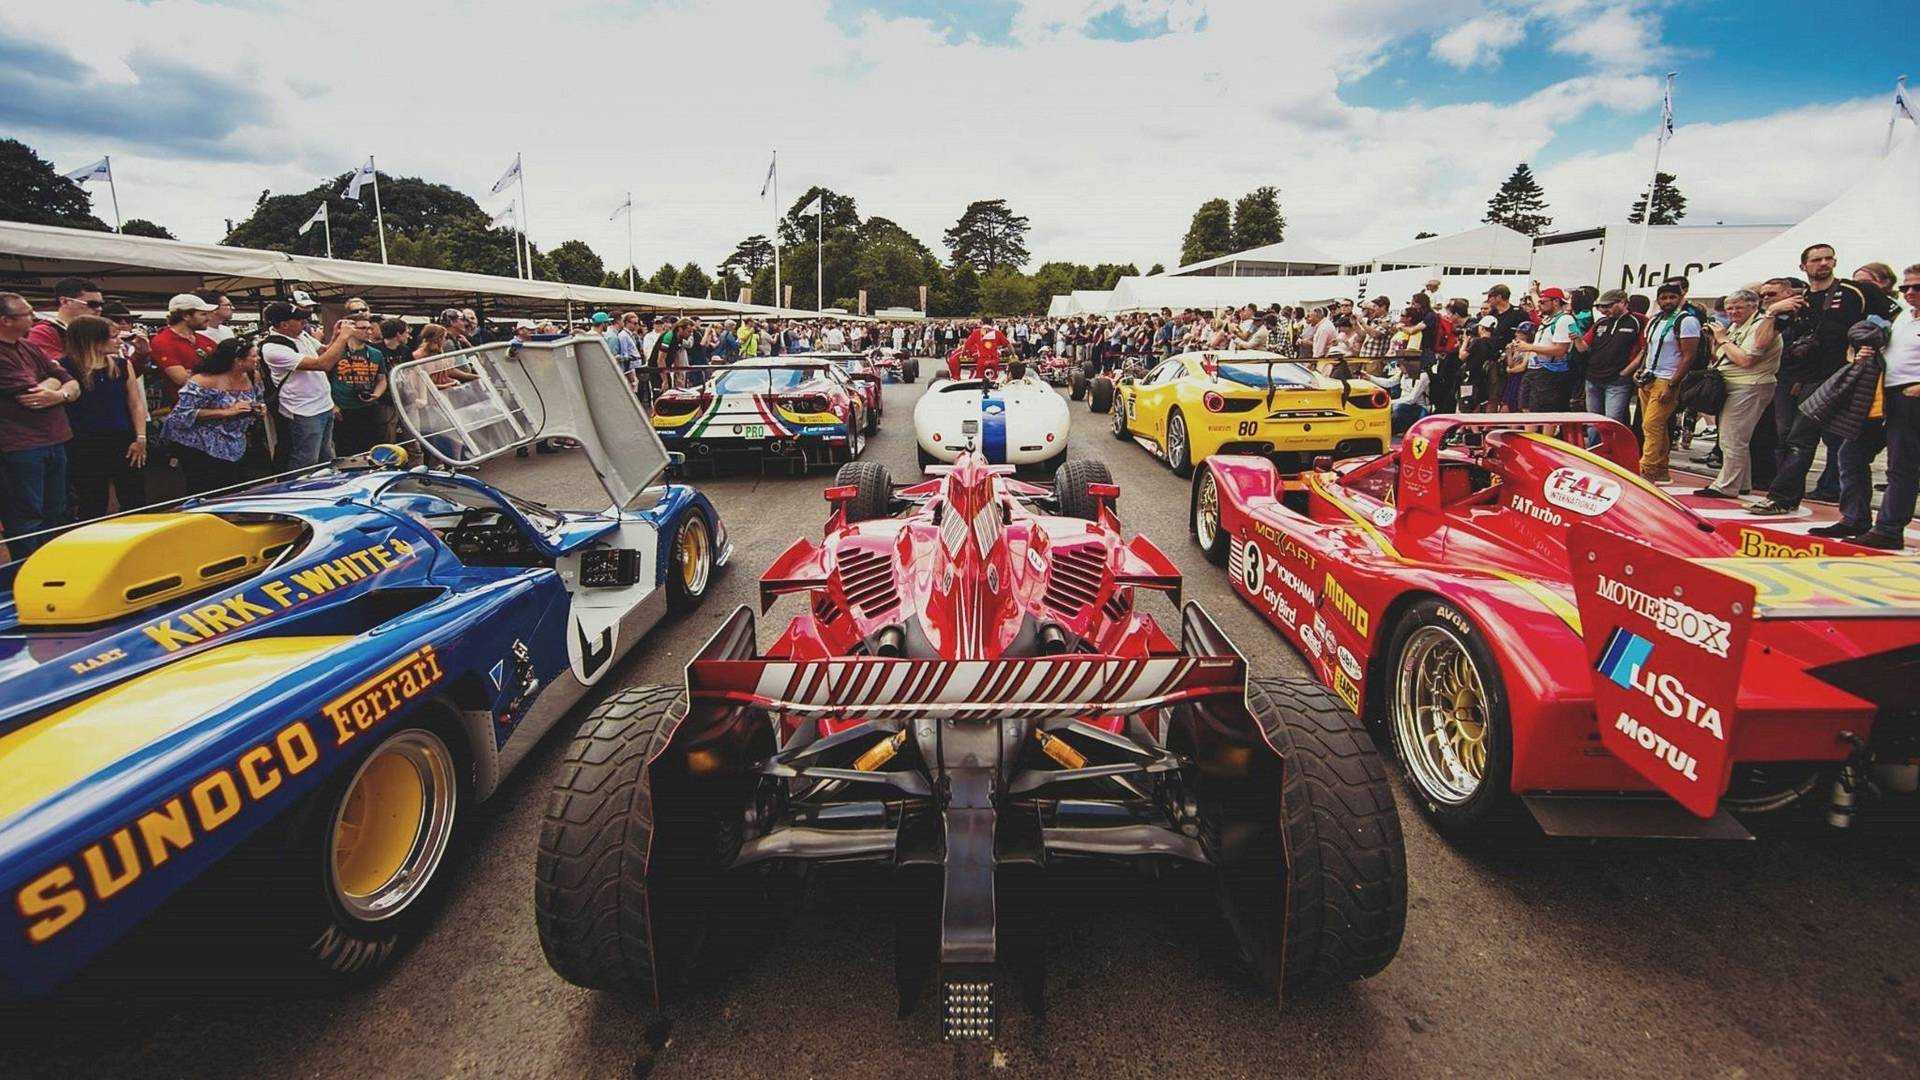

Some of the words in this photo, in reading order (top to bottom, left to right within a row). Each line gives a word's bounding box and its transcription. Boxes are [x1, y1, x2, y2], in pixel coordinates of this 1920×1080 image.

[745, 425, 765, 439] PRO
[1239, 421, 1258, 436] 80
[1511, 495, 1562, 526] FATurbo
[1551, 491, 1597, 513] INTERNATIONAL
[1247, 544, 1259, 591] 3
[1277, 563, 1315, 606] YOKOHAMA
[142, 593, 274, 652] KIRK
[1436, 606, 1470, 634] AVON
[1629, 662, 1724, 741] LISTA
[1614, 712, 1699, 783] MOTUL
[17, 721, 319, 942] SUNOCO
[322, 645, 443, 745] Ferrari
